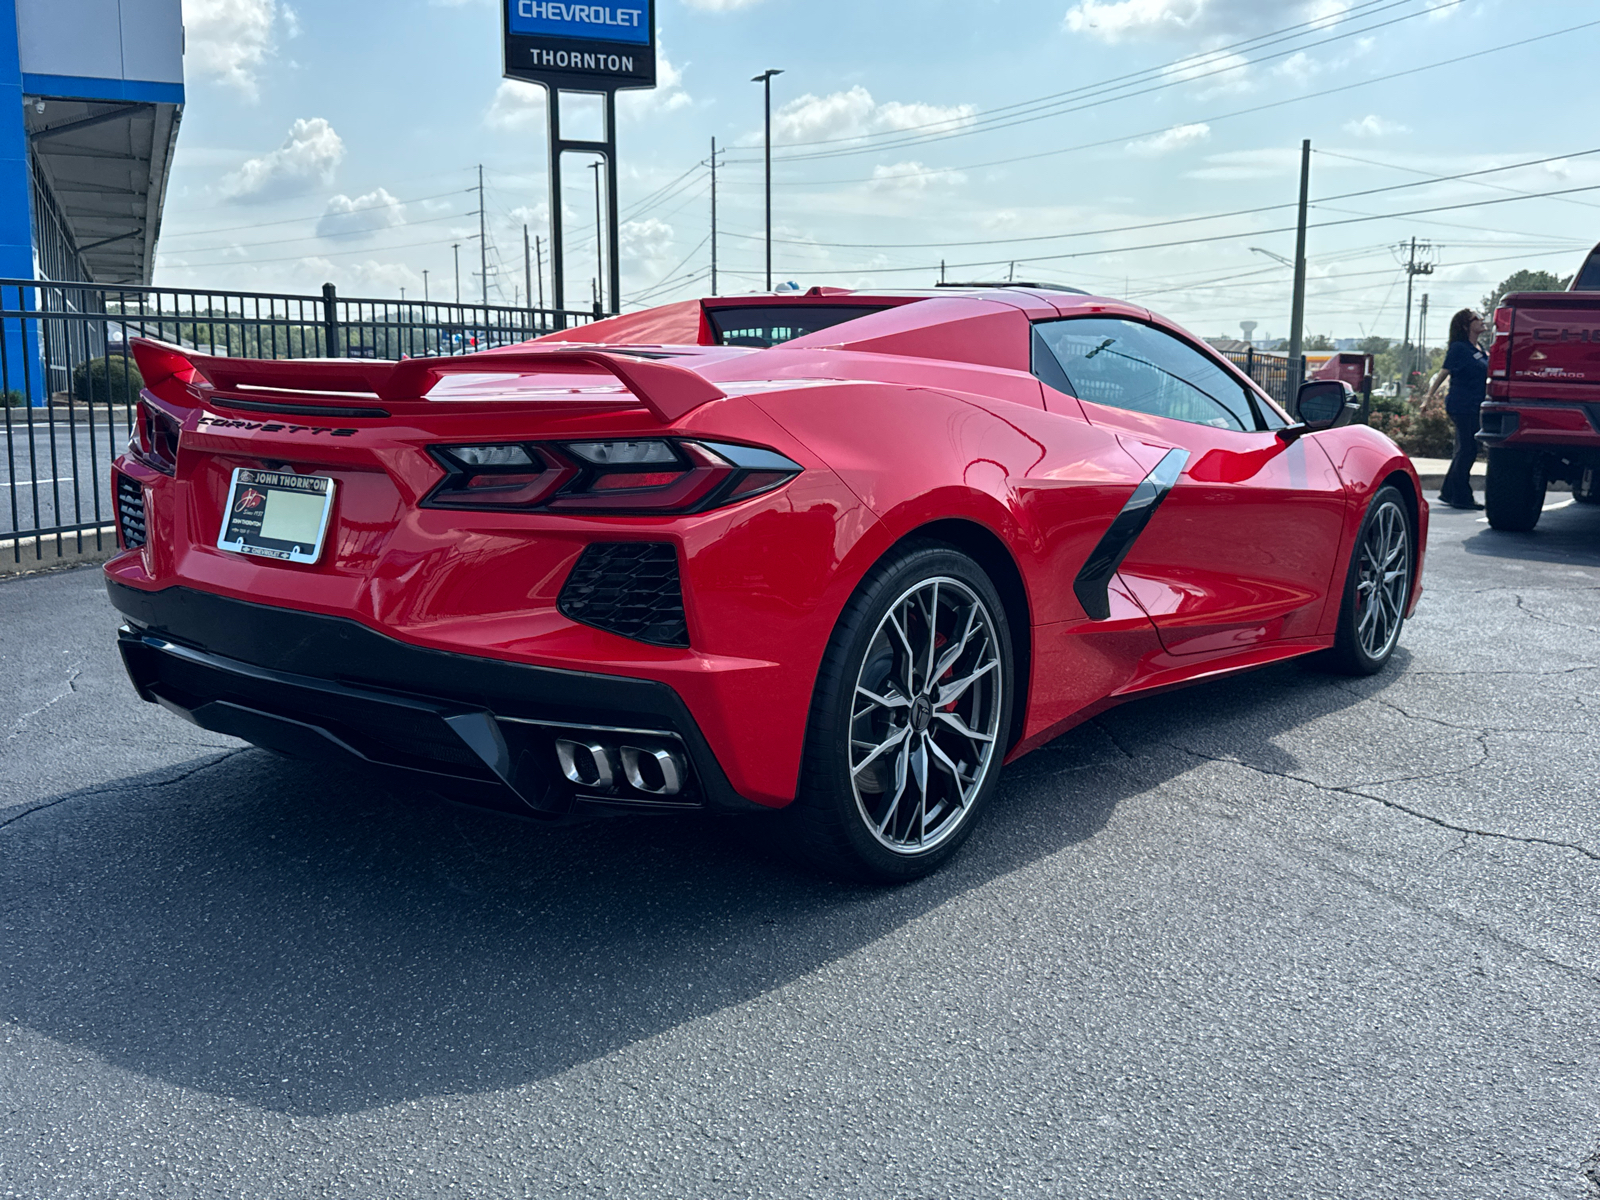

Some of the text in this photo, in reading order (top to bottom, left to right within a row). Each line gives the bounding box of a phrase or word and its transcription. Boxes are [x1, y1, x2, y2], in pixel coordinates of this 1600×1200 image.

[518, 0, 642, 27] CHEVROLET
[530, 48, 633, 72] THORNTON
[198, 417, 359, 437] CORVETTE
[255, 472, 279, 485] JOHN
[252, 547, 280, 557] CHEVROLET
